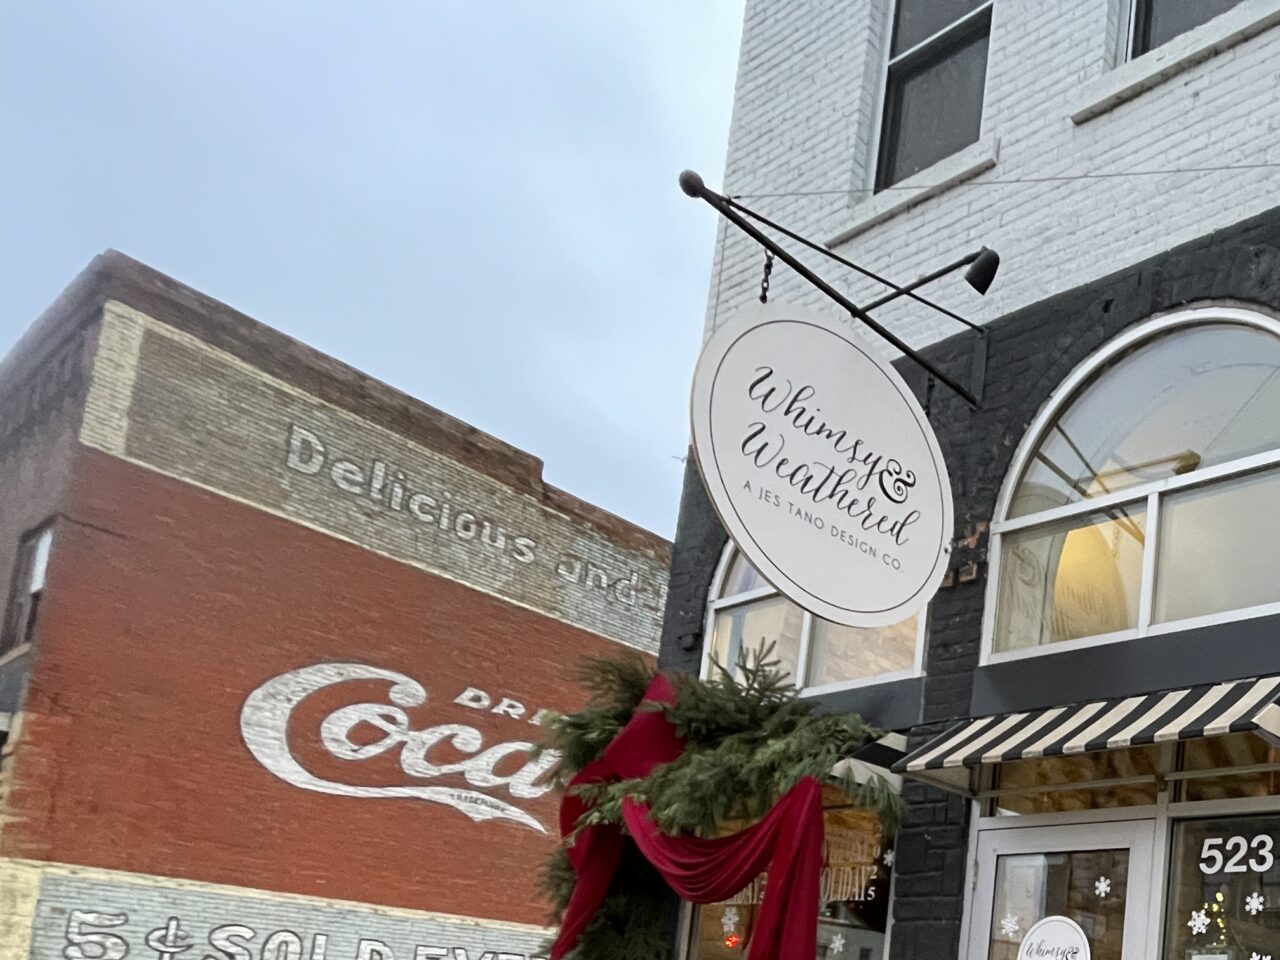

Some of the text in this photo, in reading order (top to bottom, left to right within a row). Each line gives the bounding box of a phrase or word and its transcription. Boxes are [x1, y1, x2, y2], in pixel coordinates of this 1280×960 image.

[741, 421, 921, 546] Weathered
[749, 366, 883, 490] Whimsy
[287, 424, 536, 564] Delicious
[557, 560, 638, 605] and
[743, 480, 752, 493] A
[787, 501, 825, 530] TANO
[830, 525, 877, 558] DESIGN
[241, 662, 564, 835] Coca
[820, 865, 869, 902] OLIDAY
[1199, 834, 1274, 874] 523
